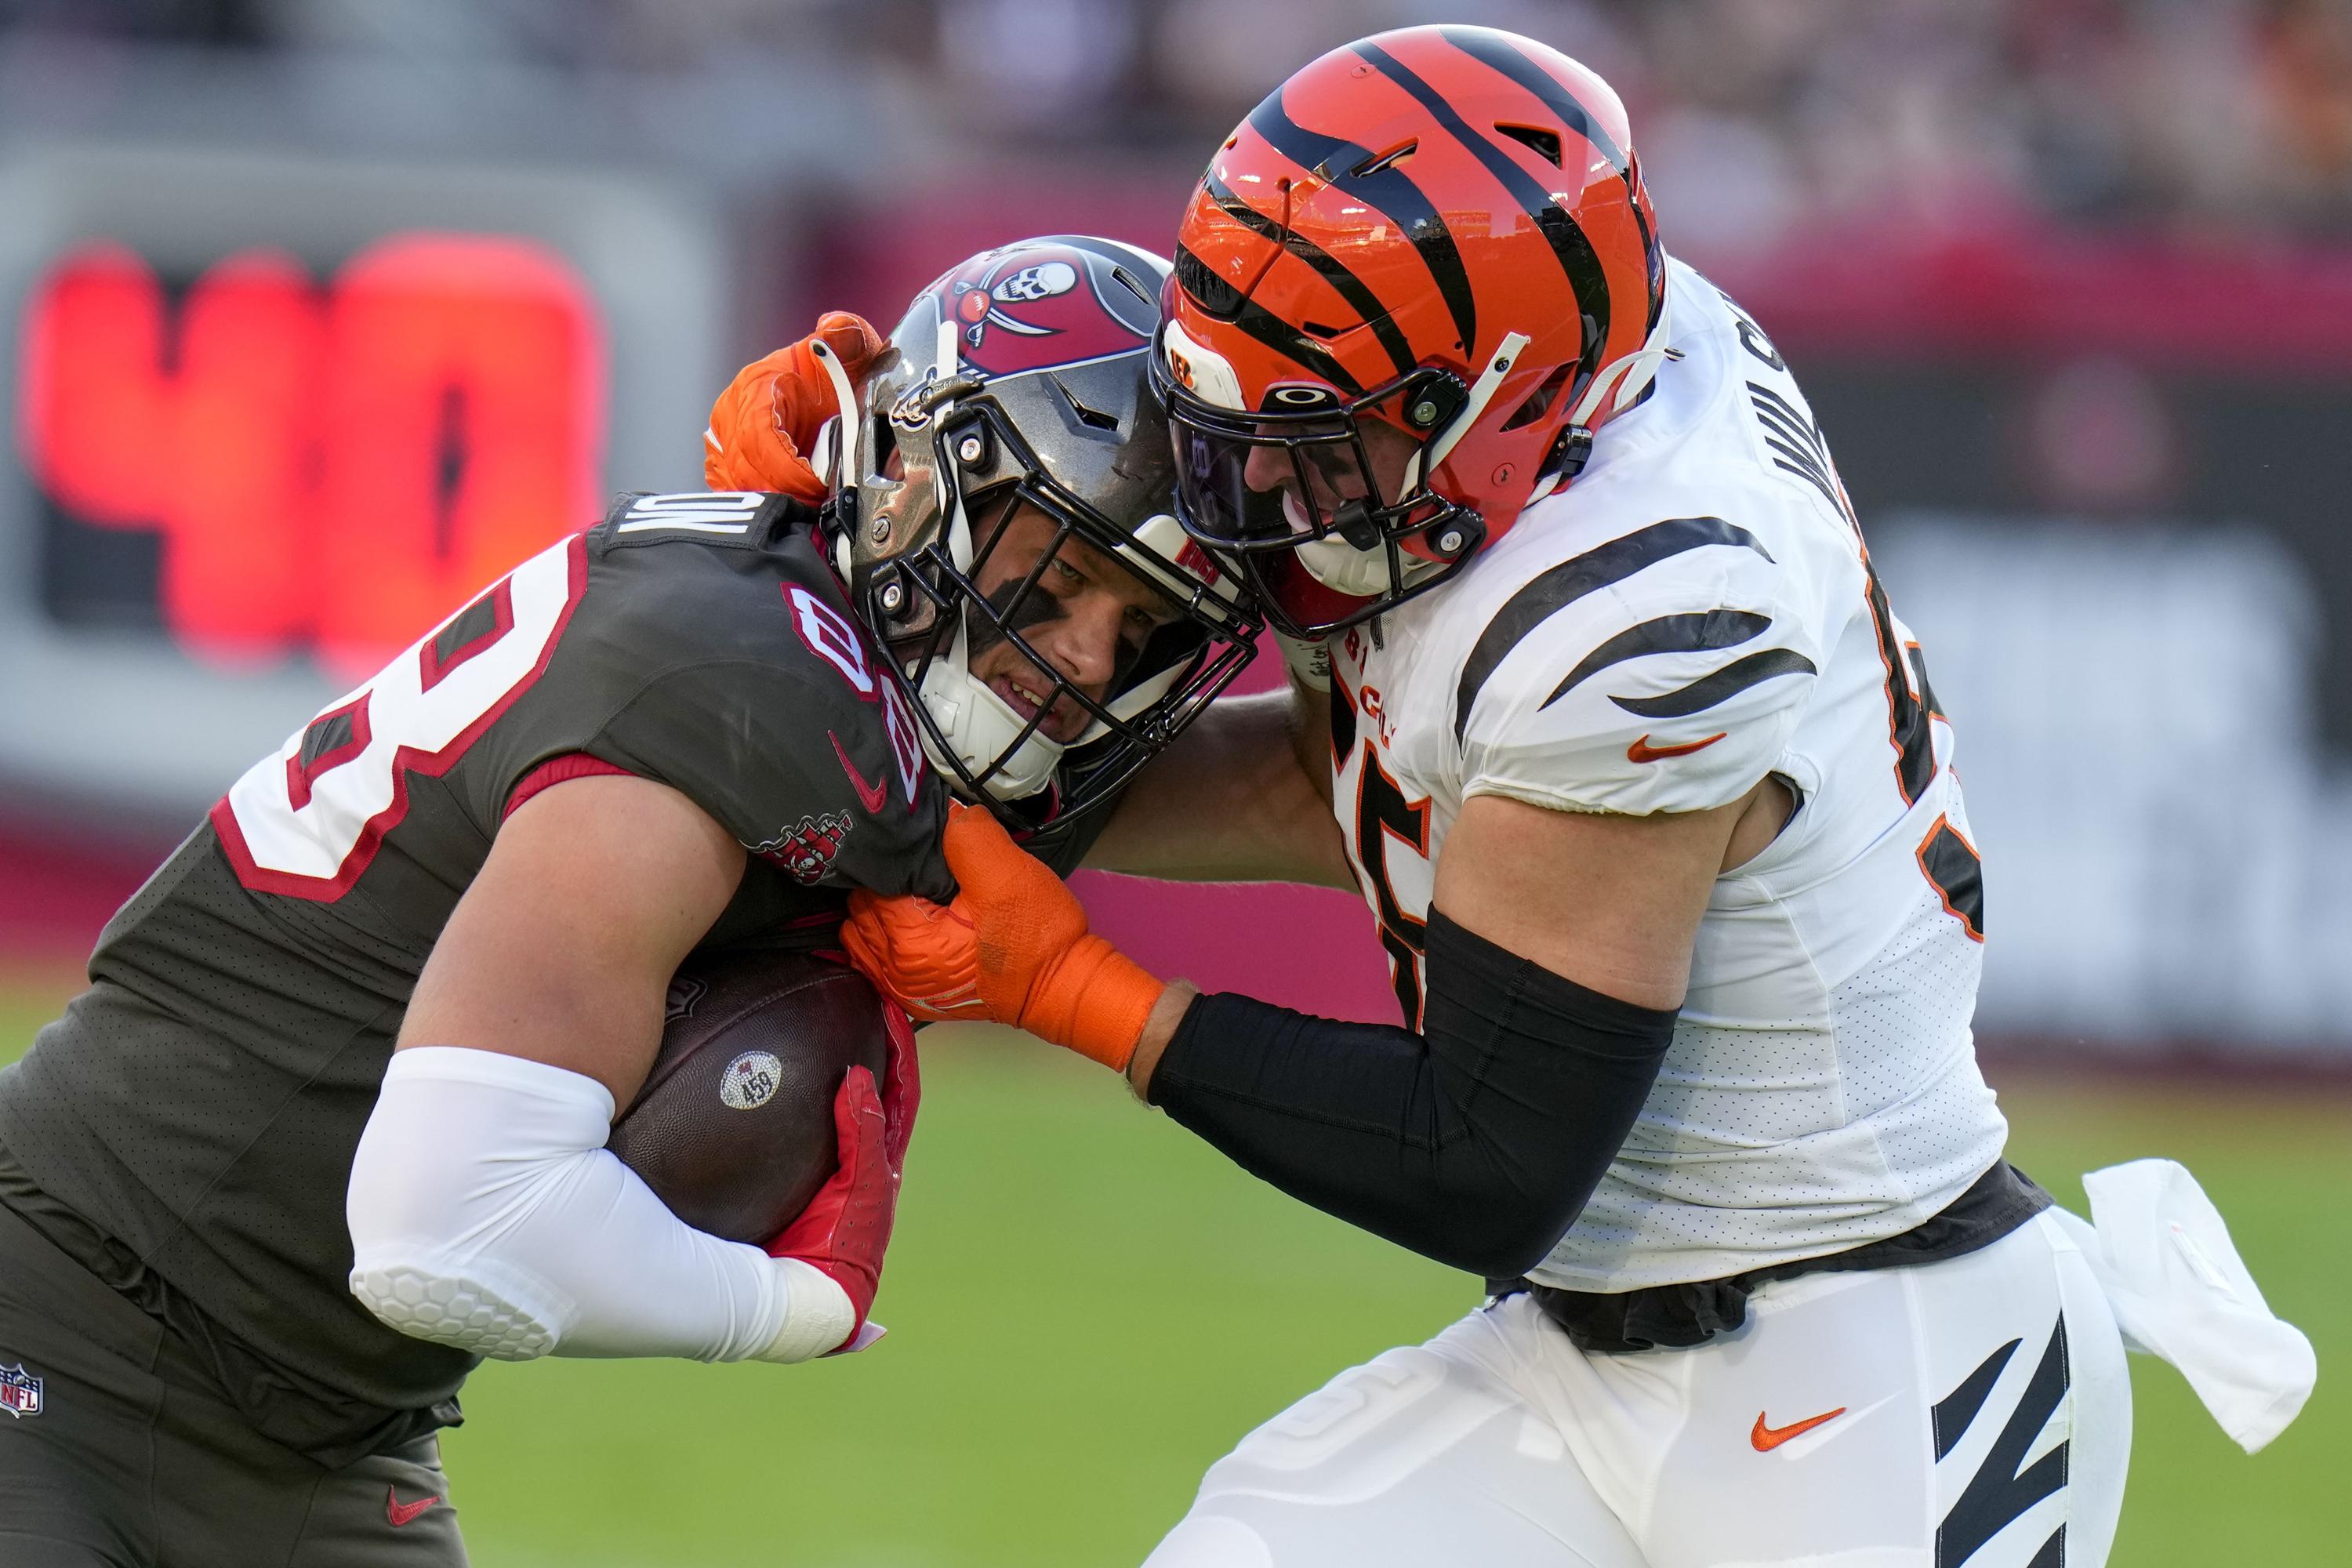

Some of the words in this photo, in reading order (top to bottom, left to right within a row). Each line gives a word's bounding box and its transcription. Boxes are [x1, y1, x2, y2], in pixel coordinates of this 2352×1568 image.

[19, 237, 608, 681] 40
[1174, 536, 1221, 586] BUCS
[741, 1071, 773, 1104] 459
[2, 1382, 36, 1410] NFL
